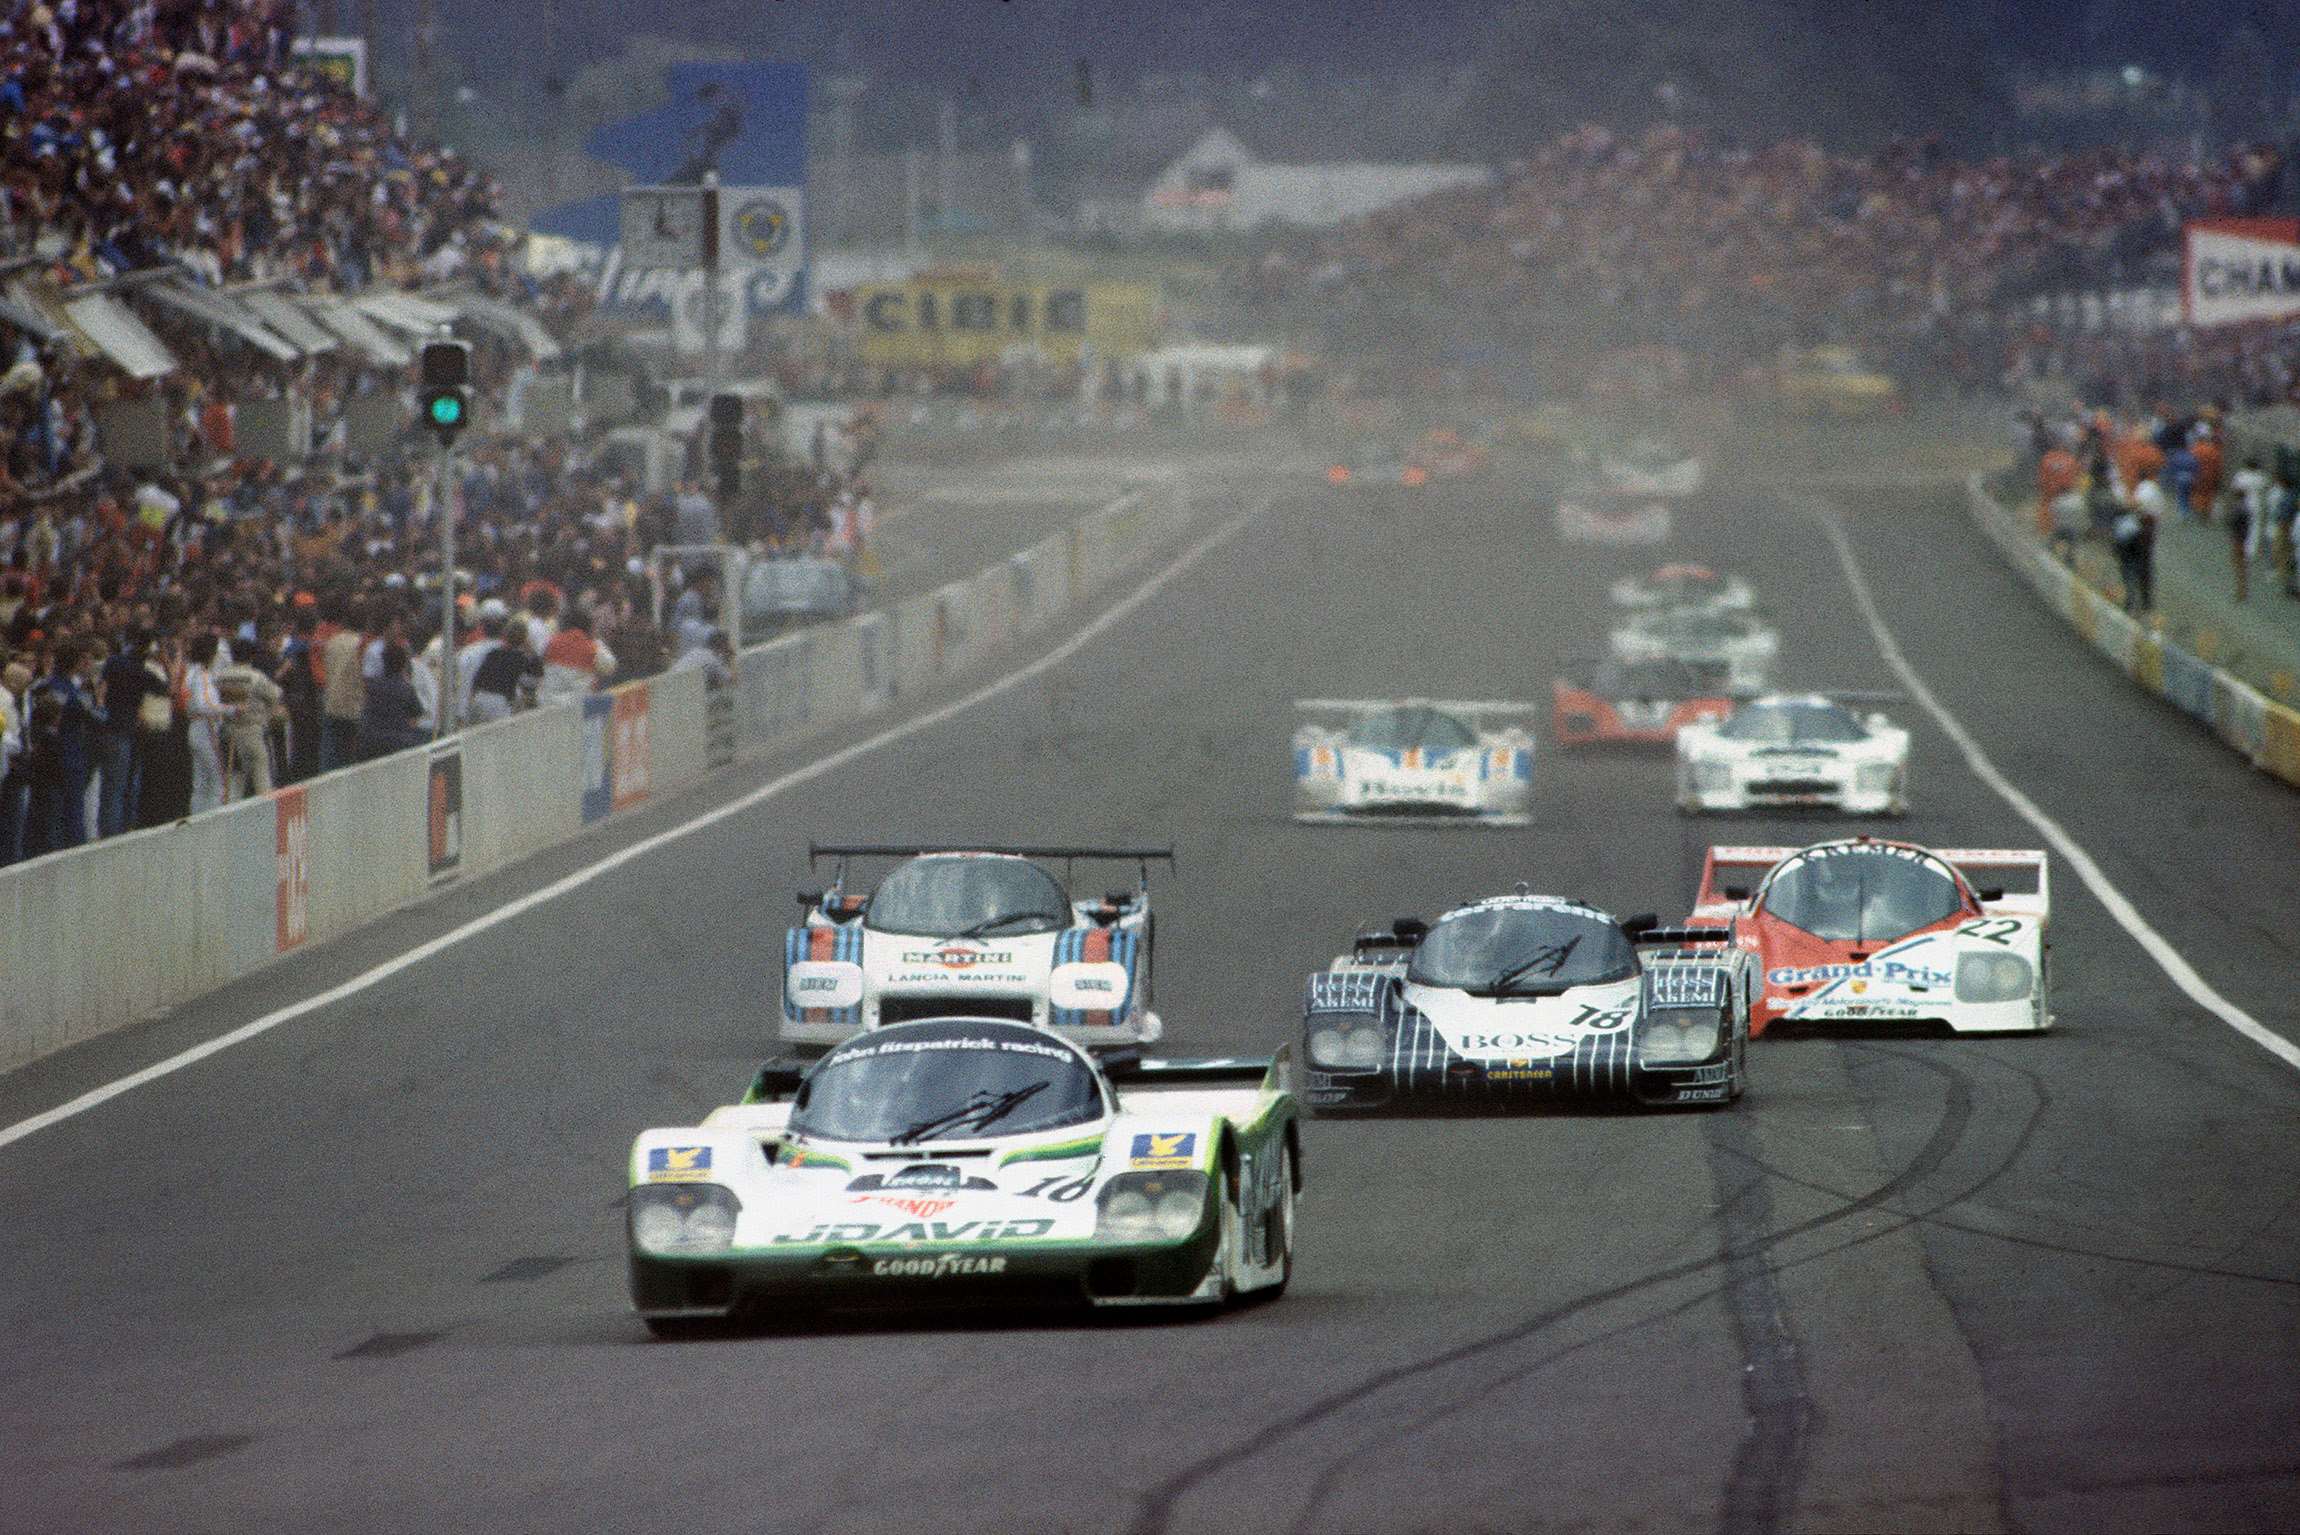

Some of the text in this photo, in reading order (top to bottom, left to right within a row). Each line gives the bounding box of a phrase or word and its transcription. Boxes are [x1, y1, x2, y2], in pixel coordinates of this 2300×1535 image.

[1956, 919, 2022, 945] 22
[901, 951, 1013, 964] MARTINI
[888, 973, 1027, 983] LANCIA MARTINI
[1569, 1003, 1633, 1029] 18
[1000, 1040, 1073, 1064] racing
[1461, 1034, 1577, 1049] BOSS
[872, 1253, 1008, 1278] GOODYEAR
